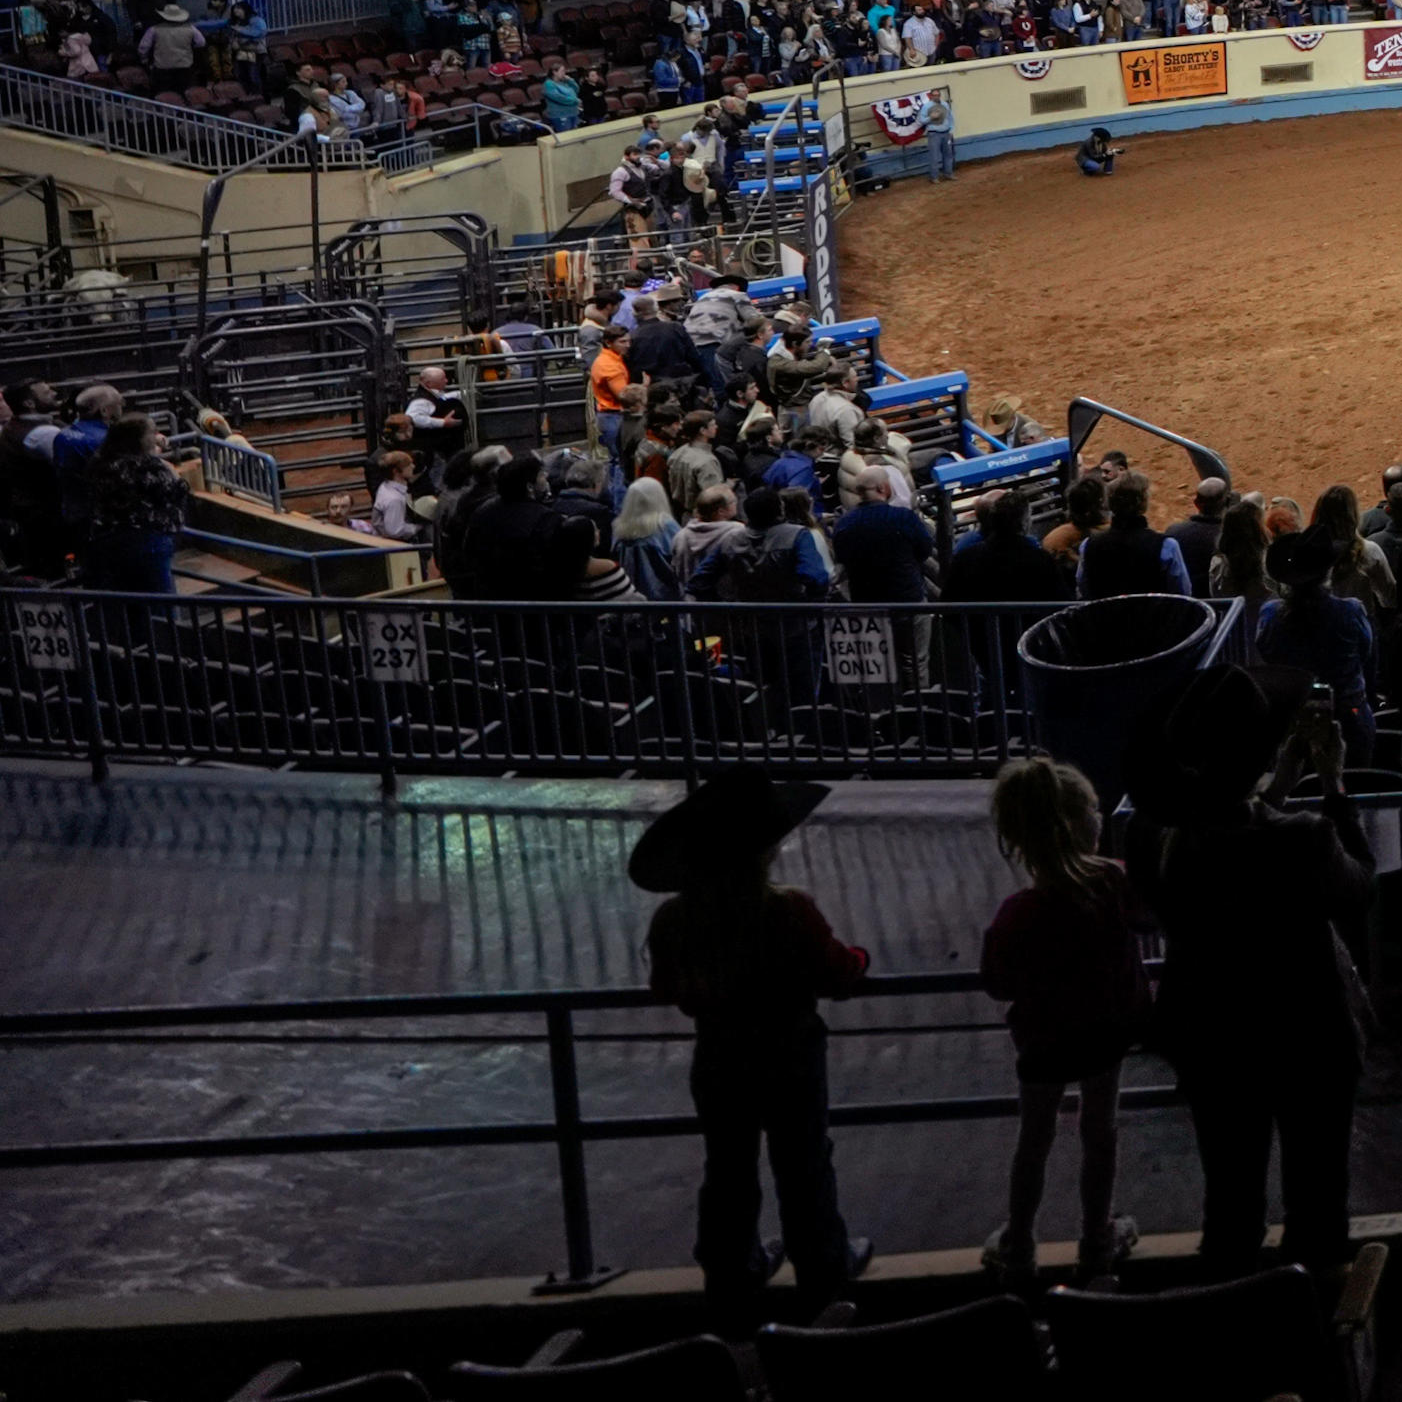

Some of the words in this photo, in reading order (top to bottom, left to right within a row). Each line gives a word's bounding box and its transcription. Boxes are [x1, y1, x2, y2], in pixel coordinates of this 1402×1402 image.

[1163, 49, 1219, 65] SHORTY'S
[814, 182, 836, 326] RODEO
[23, 610, 67, 629] BOX
[832, 616, 880, 634] ADA
[29, 636, 70, 658] 238
[373, 647, 417, 668] 237
[839, 660, 881, 675] ONLY
